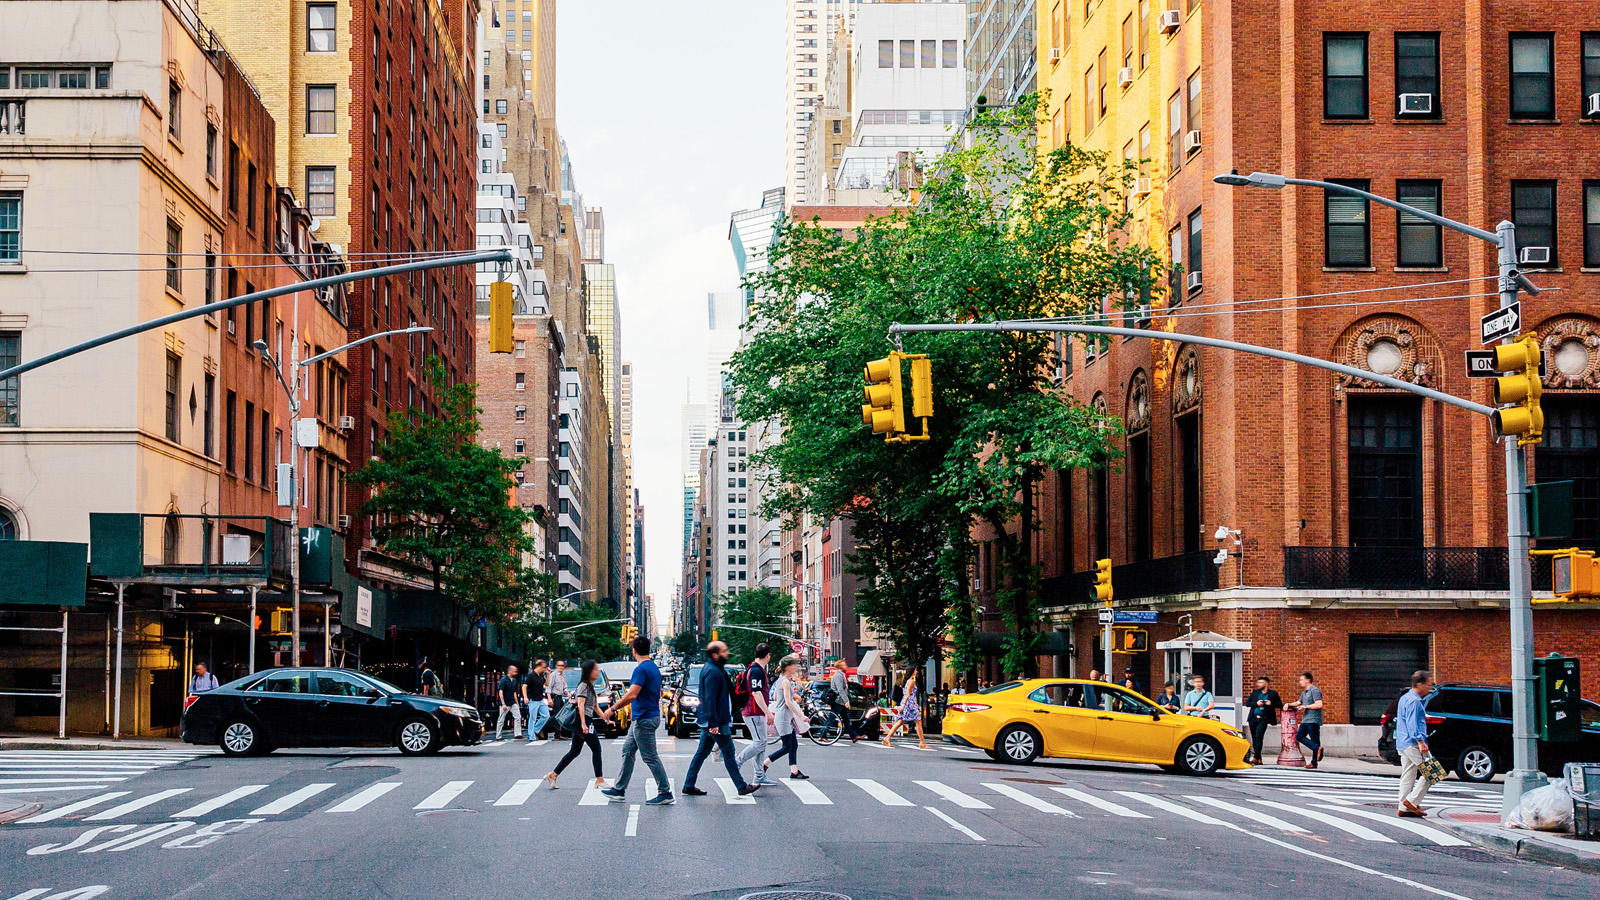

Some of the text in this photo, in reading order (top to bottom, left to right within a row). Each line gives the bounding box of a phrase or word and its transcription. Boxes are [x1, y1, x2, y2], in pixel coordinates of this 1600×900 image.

[1487, 313, 1514, 333] ONE WAY
[1478, 359, 1493, 370] ON
[1203, 641, 1227, 649] POLICE
[26, 818, 266, 855] BUS
